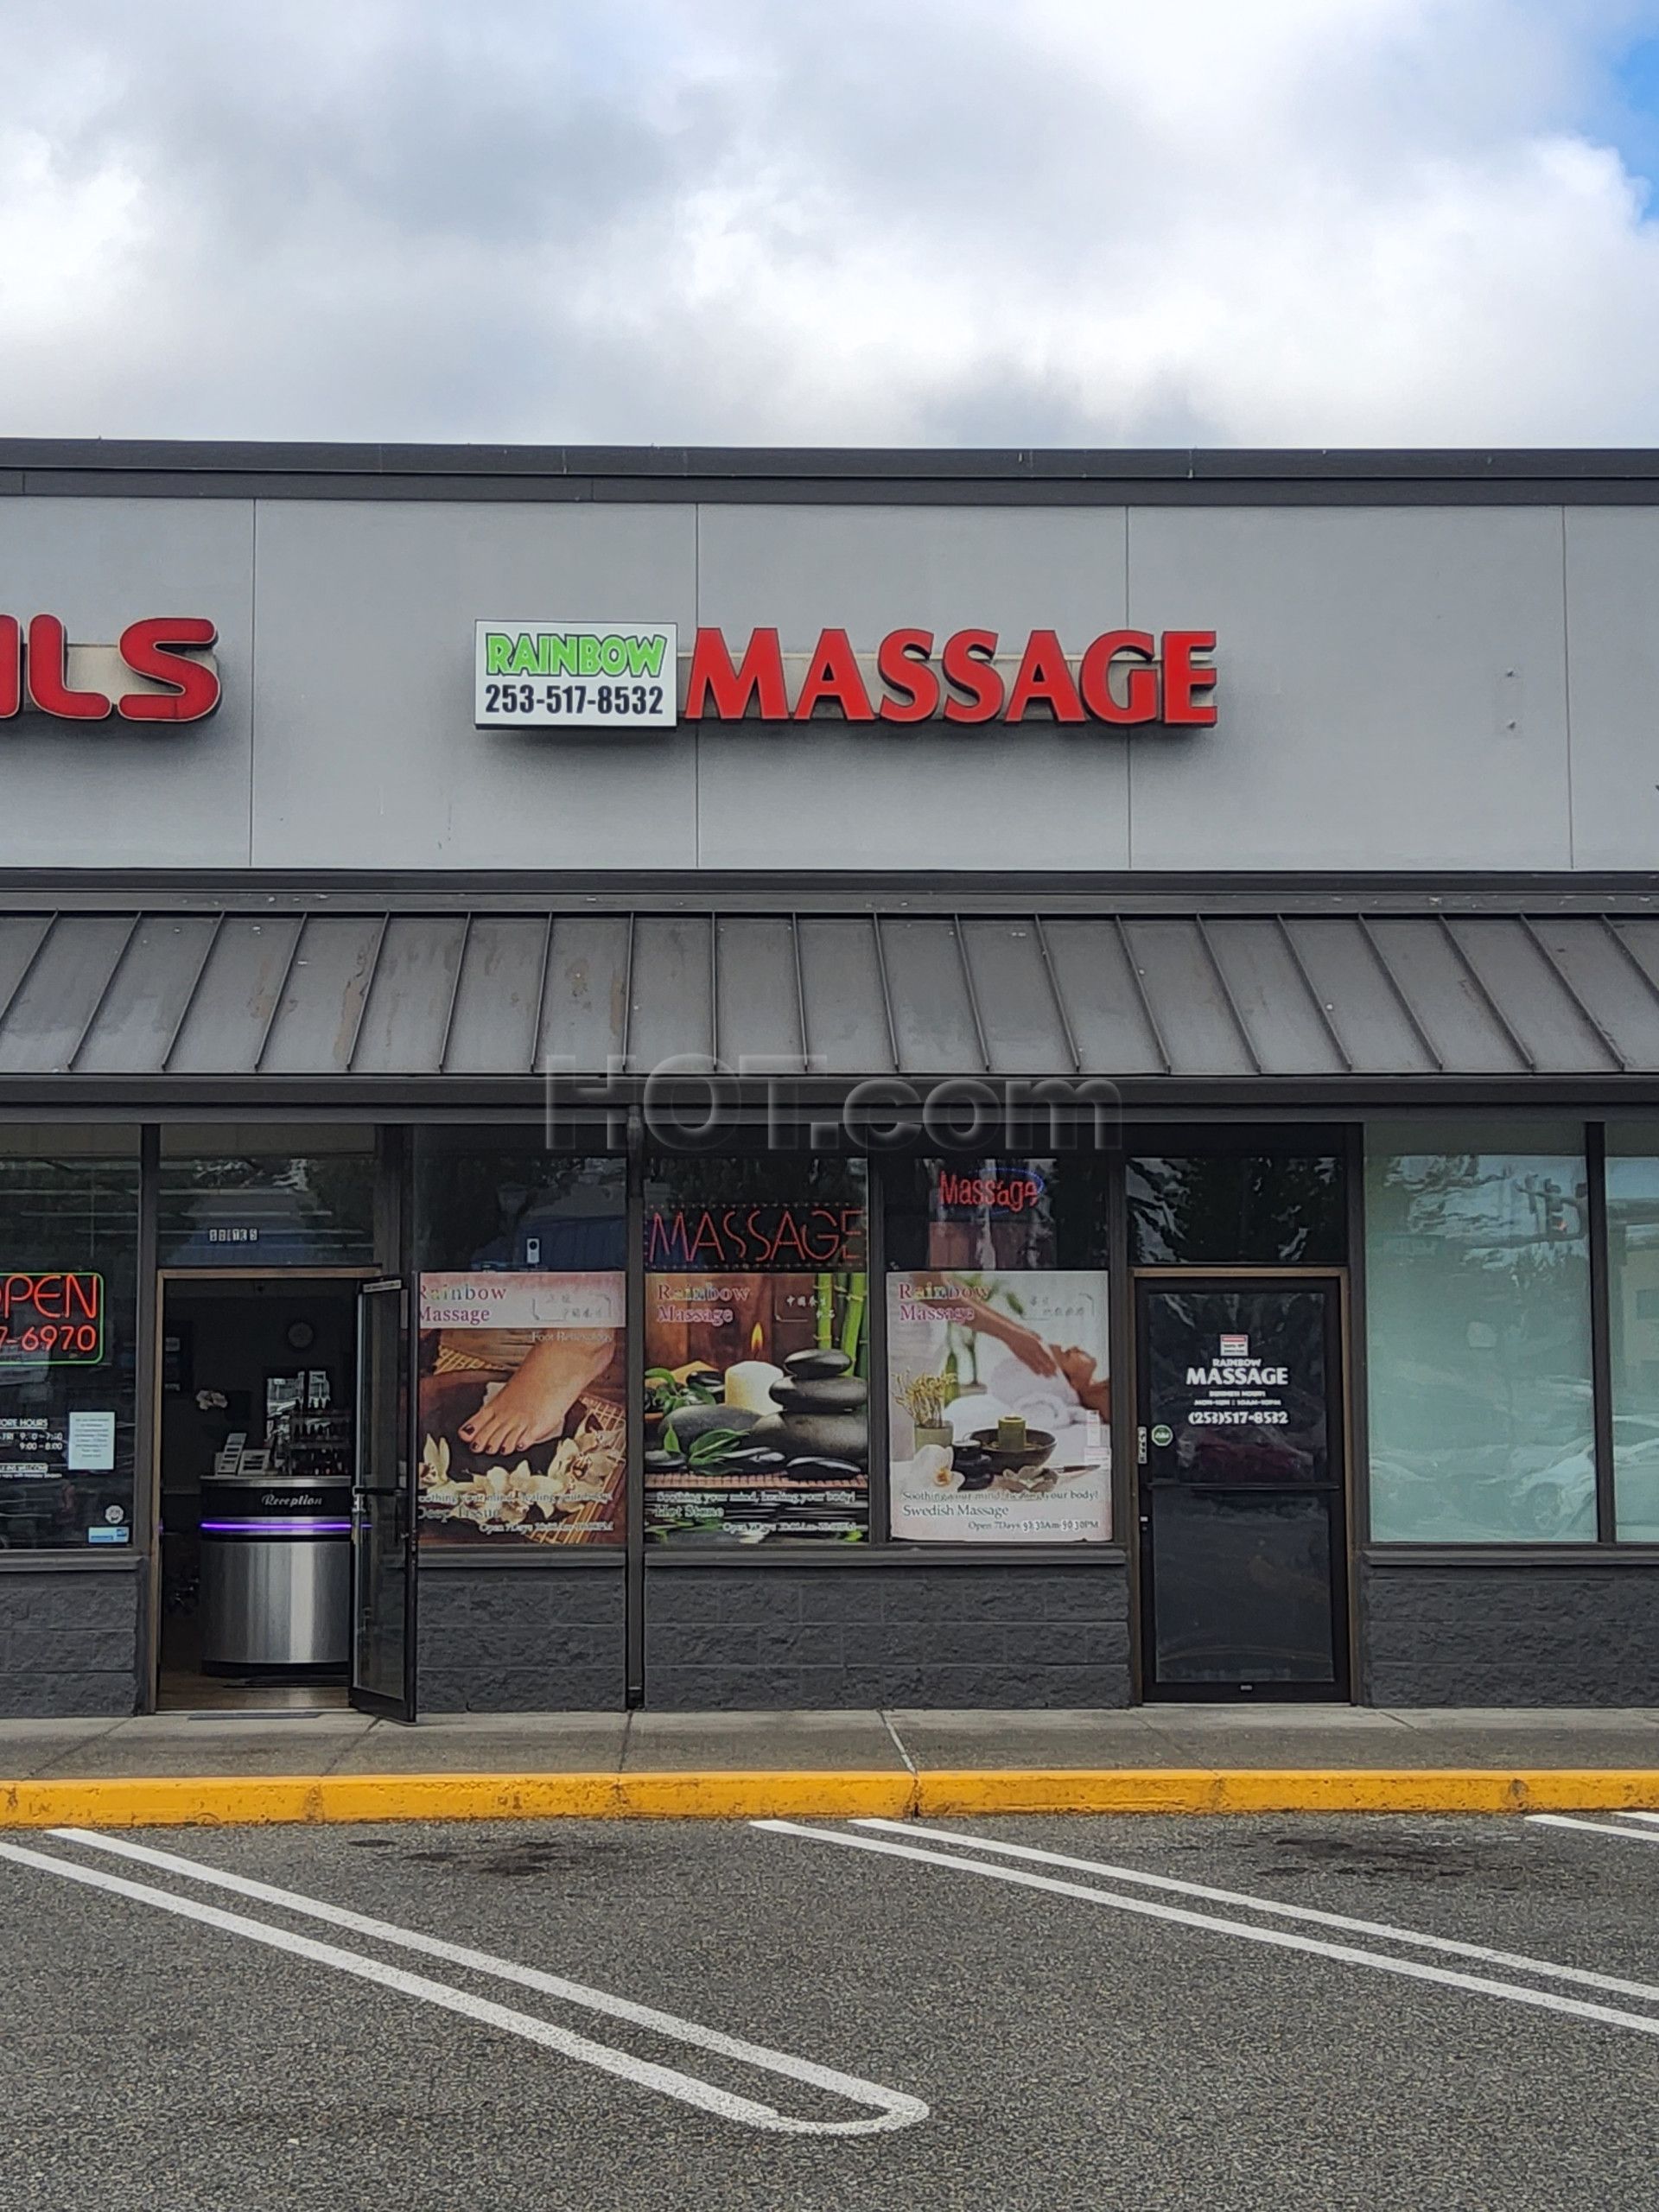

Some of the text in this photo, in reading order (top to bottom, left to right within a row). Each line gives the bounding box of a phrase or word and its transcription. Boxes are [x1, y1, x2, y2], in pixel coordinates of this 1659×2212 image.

[486, 633, 667, 677] RAINBOW
[685, 627, 1217, 725] MASSAGE
[485, 683, 664, 715] 253-517-8532
[939, 1170, 1038, 1213] Massage
[649, 1210, 864, 1263] MASSAGE
[0, 1273, 98, 1319] PEN
[420, 1284, 507, 1300] Rainbow
[657, 1282, 750, 1302] Rainbow
[898, 1282, 993, 1300] Rainbow
[420, 1306, 491, 1325] Massage
[657, 1304, 734, 1326] Massage
[899, 1304, 976, 1324] Massage
[1212, 1358, 1262, 1367] RAINBOW
[1185, 1367, 1289, 1385] MASSAGE
[1188, 1411, 1289, 1425] (253)517-8532
[261, 1494, 323, 1508] Reception
[903, 1503, 1008, 1518] Swedish Massage
[684, 1504, 724, 1518] Stone
[968, 1521, 993, 1531] Open
